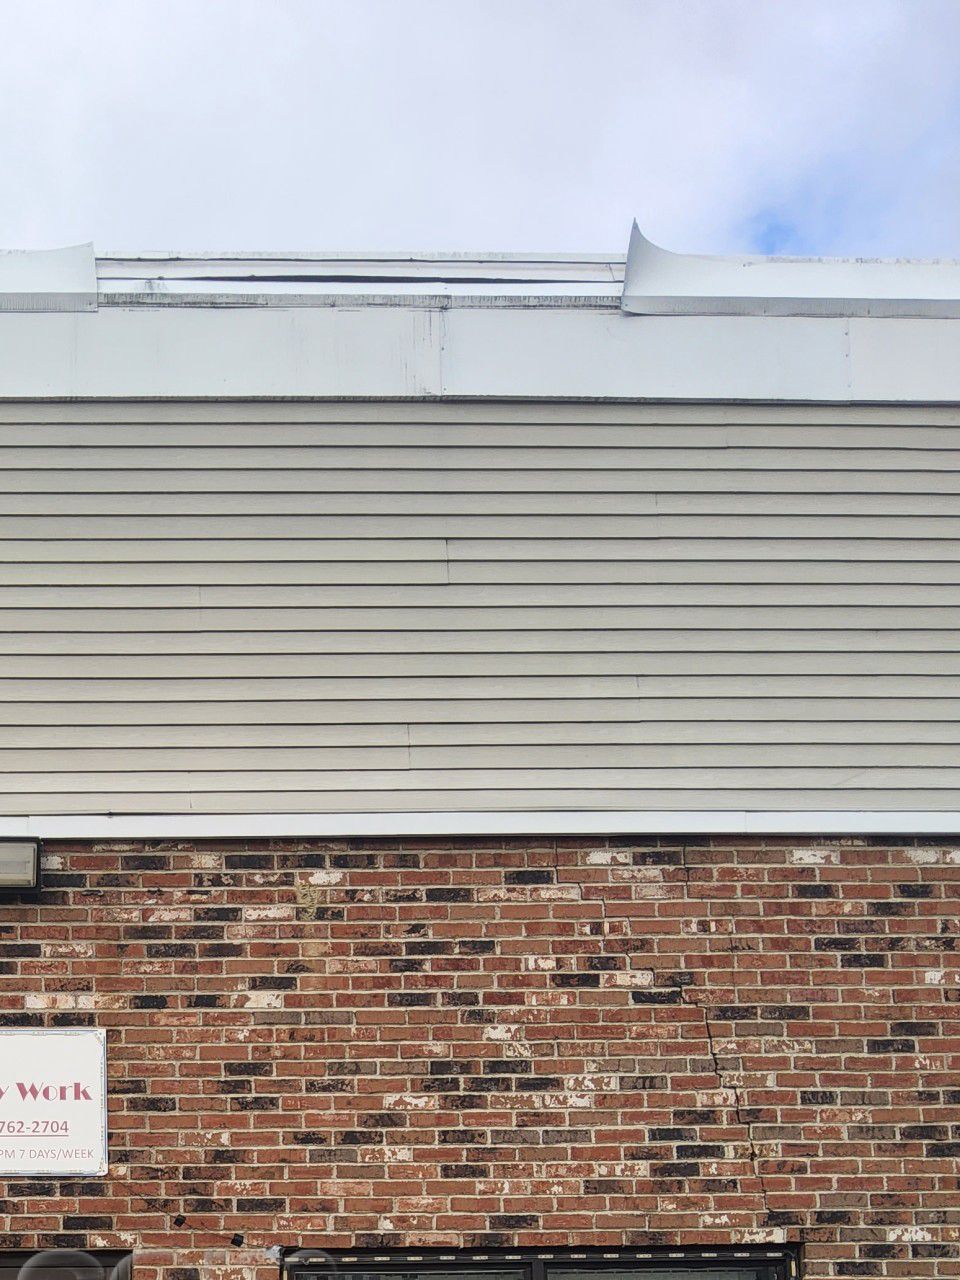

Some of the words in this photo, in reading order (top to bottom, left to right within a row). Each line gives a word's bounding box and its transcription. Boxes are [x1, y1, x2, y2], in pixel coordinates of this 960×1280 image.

[16, 1082, 93, 1101] Work
[19, 1150, 25, 1160] 7
[29, 1149, 94, 1161] DAYS/WEEK
